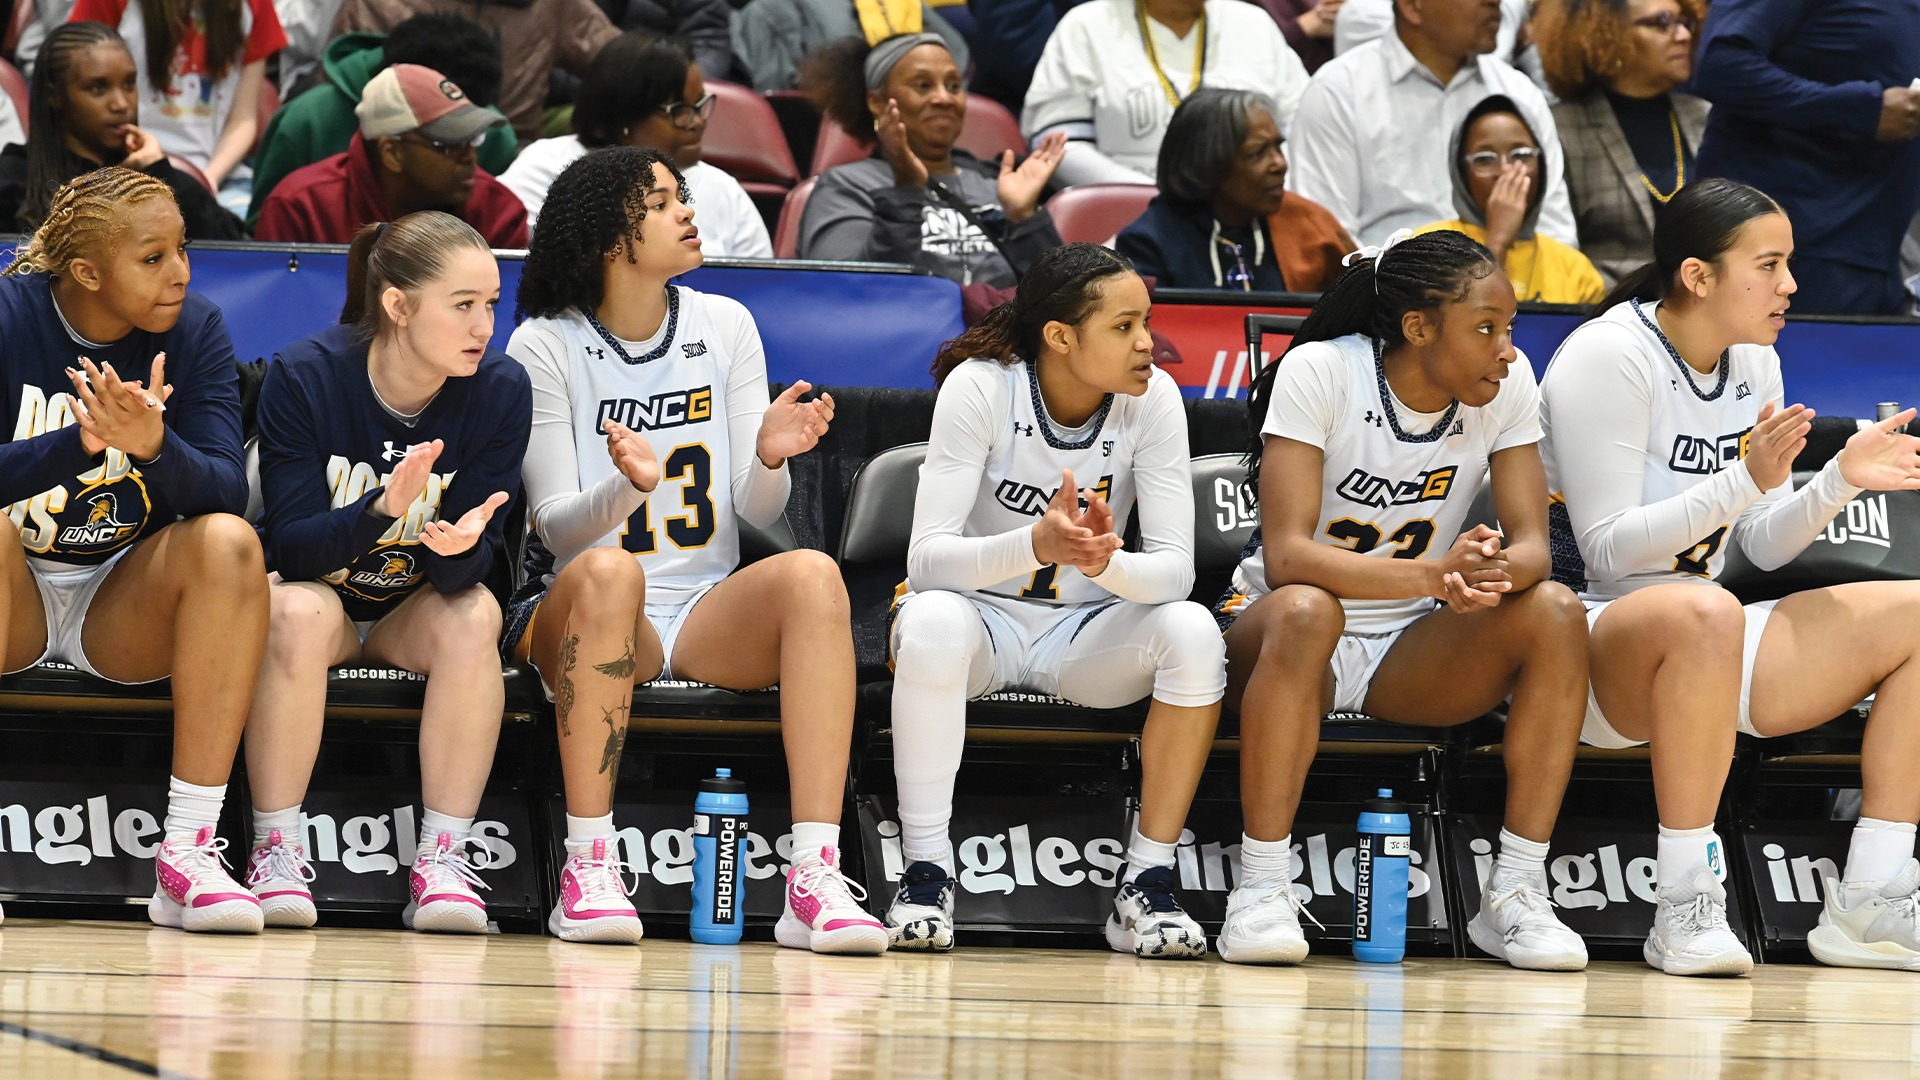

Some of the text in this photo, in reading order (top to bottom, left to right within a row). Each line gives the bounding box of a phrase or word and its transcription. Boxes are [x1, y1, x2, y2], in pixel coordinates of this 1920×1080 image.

[596, 385, 711, 435] UNCG
[995, 474, 1113, 517] UN
[1336, 465, 1459, 509] UNCG
[59, 526, 137, 547] UNCG
[0, 795, 166, 866] ngle
[300, 804, 517, 876] ngls
[877, 823, 1127, 895] igles
[717, 817, 736, 921] POWERADE
[1356, 837, 1371, 939] POWERADE
[1470, 838, 1657, 911] igle
